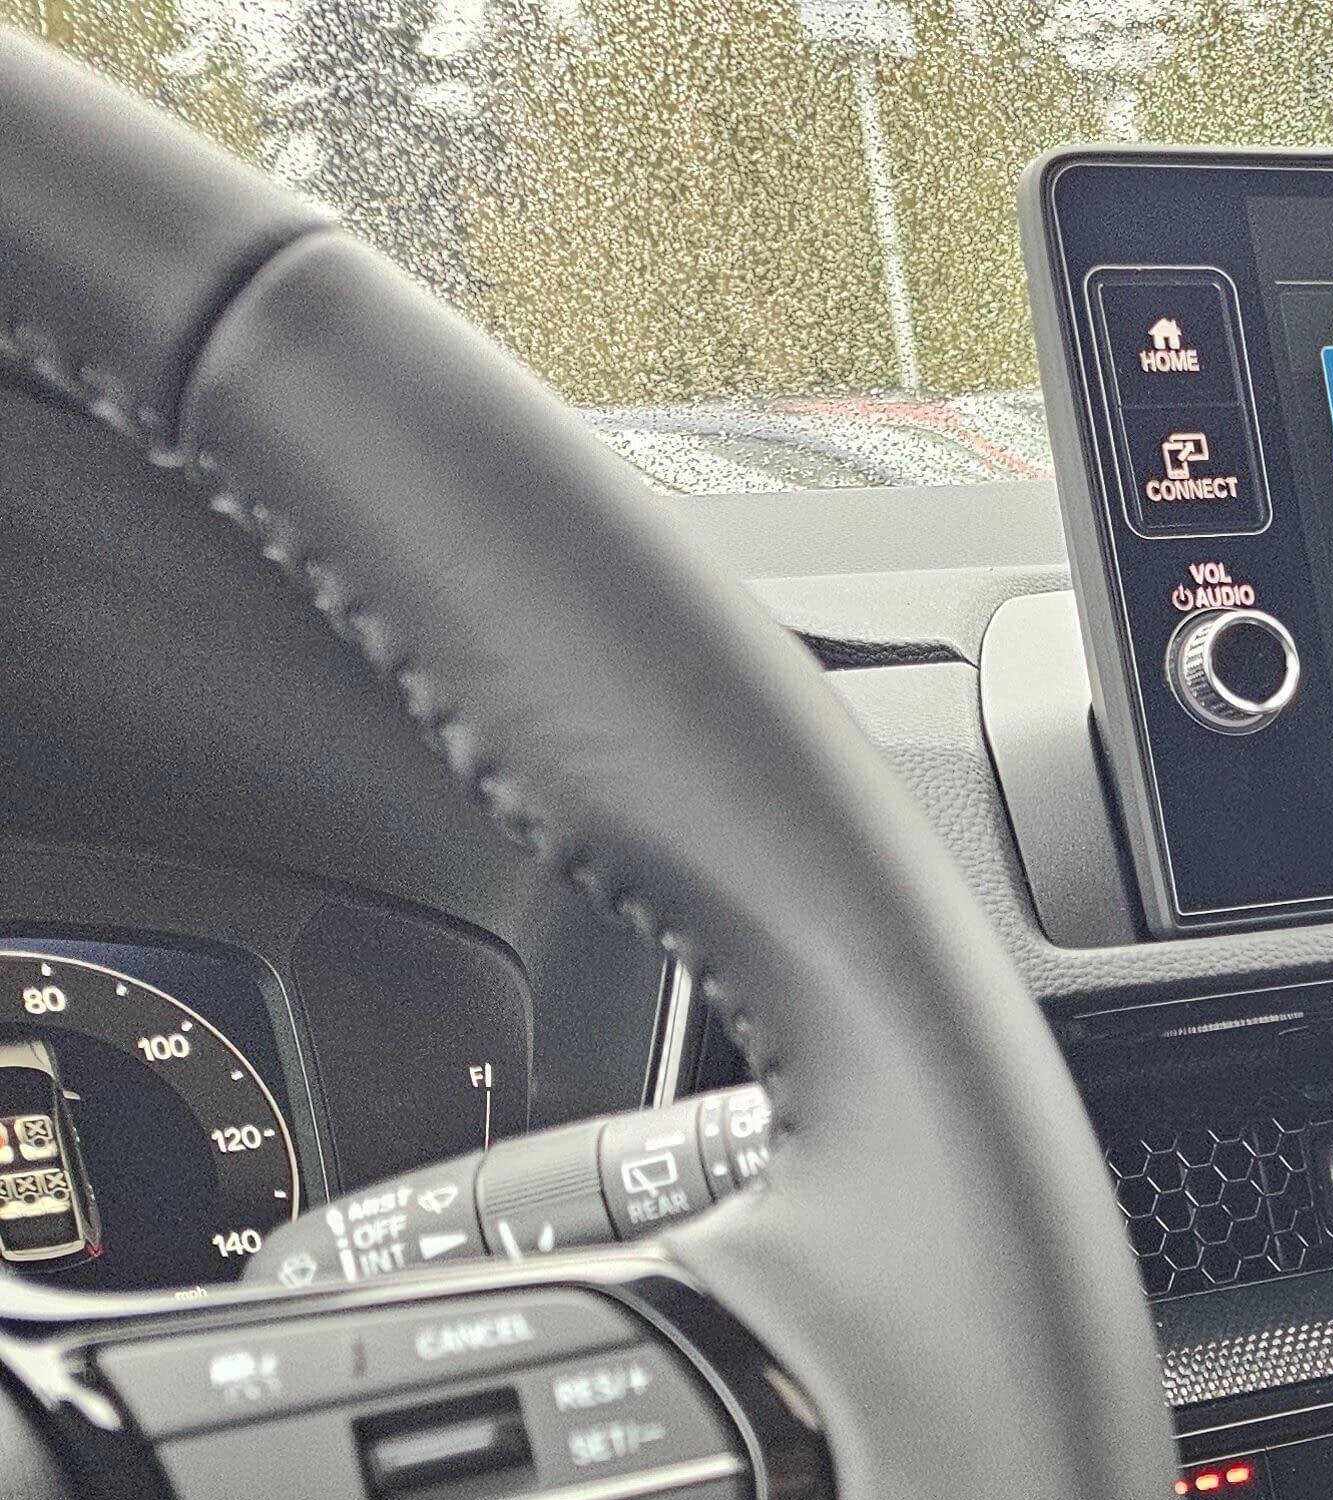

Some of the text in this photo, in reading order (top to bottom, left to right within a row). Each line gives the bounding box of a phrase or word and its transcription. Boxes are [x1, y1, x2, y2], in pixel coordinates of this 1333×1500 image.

[1139, 350, 1200, 373] HOME
[1146, 476, 1238, 502] CONNECT
[1189, 561, 1232, 585] VOL
[1195, 584, 1256, 609] AUDIO
[22, 985, 67, 1015] 80
[137, 1033, 190, 1062] 100
[469, 1066, 484, 1088] F
[211, 1124, 262, 1153] 120
[626, 1189, 691, 1225] REAR
[212, 1229, 262, 1257] 140
[353, 1213, 409, 1250] OFF
[359, 1242, 407, 1279] INT
